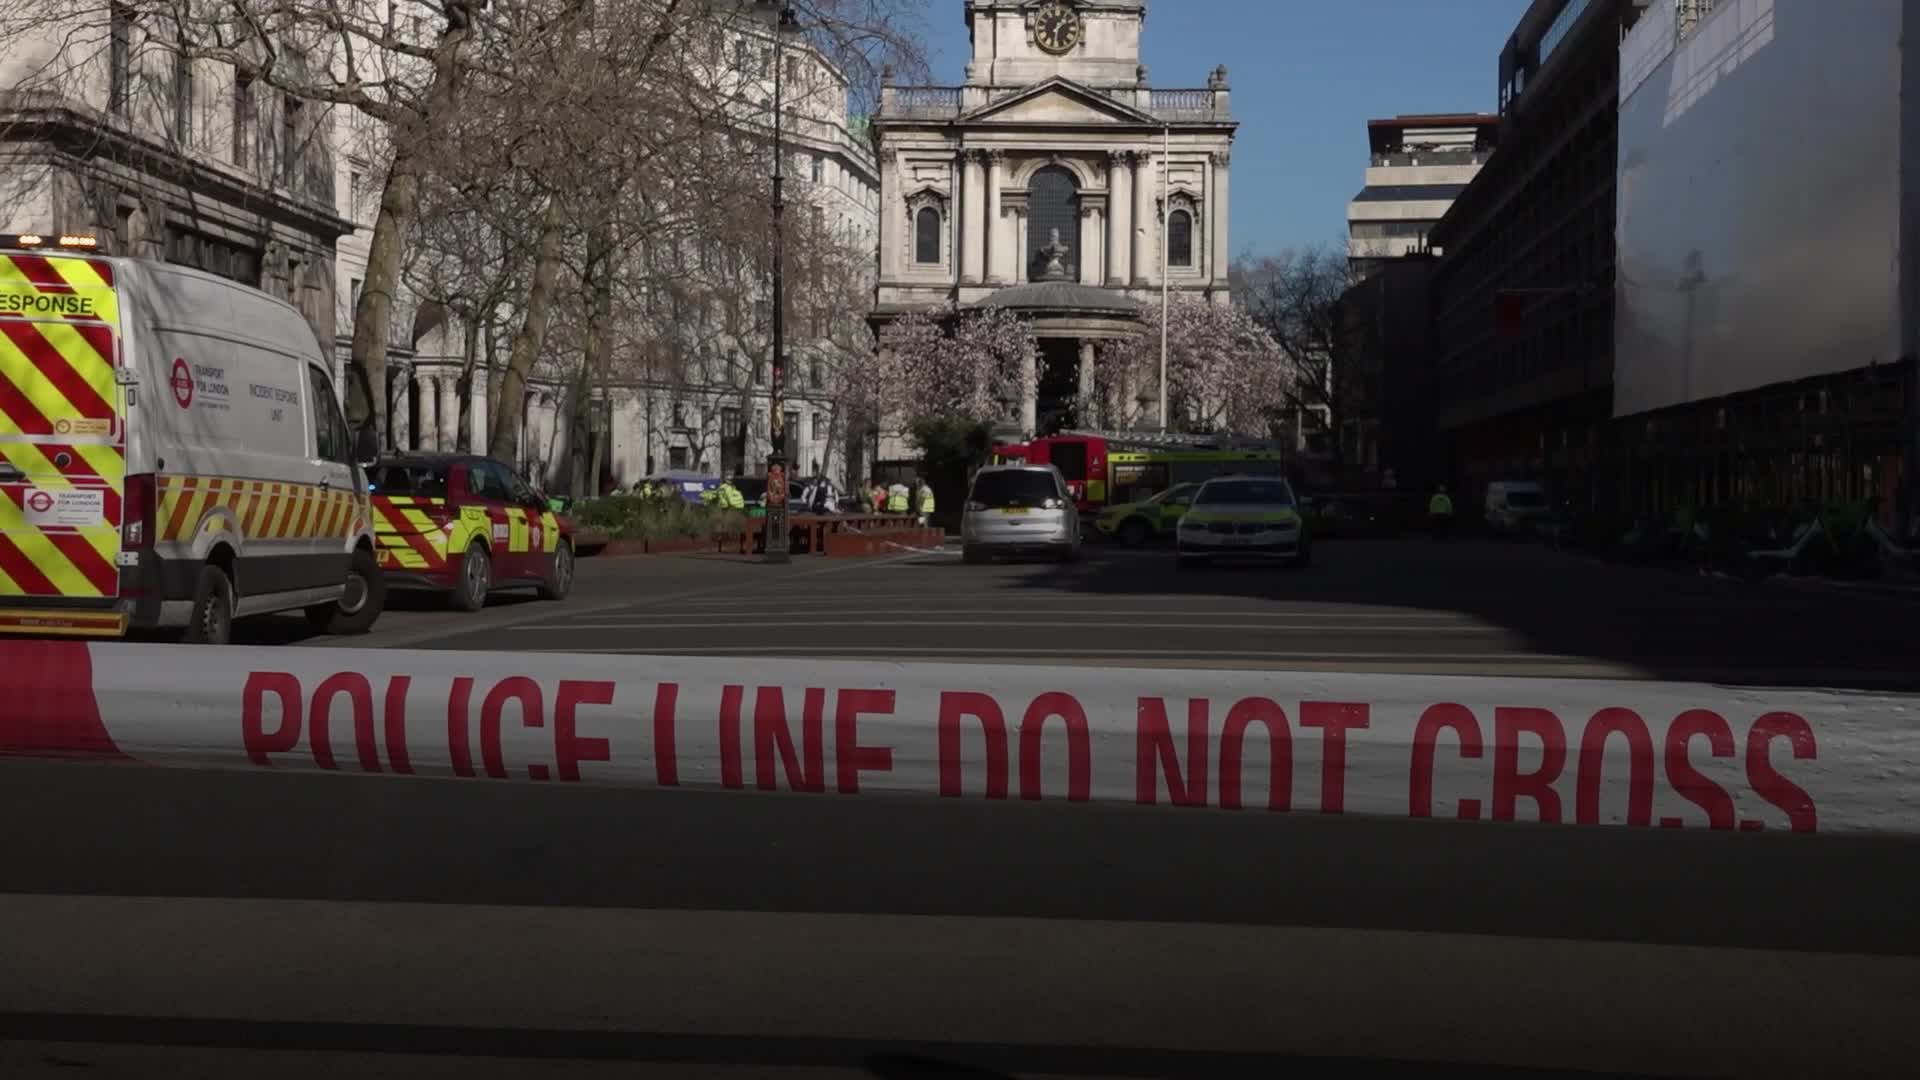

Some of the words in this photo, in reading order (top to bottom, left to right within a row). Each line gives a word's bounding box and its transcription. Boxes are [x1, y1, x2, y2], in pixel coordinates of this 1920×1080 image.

[194, 364, 225, 378] TRANSPORT
[207, 383, 230, 396] LONDON
[248, 384, 273, 398] INCIDENT
[274, 388, 298, 405] RESPONSE
[242, 671, 616, 782] POLICE
[654, 682, 896, 794] LINE
[937, 690, 1091, 803] DO
[1135, 696, 1370, 814] NOT
[1408, 701, 1817, 834] CROSS
